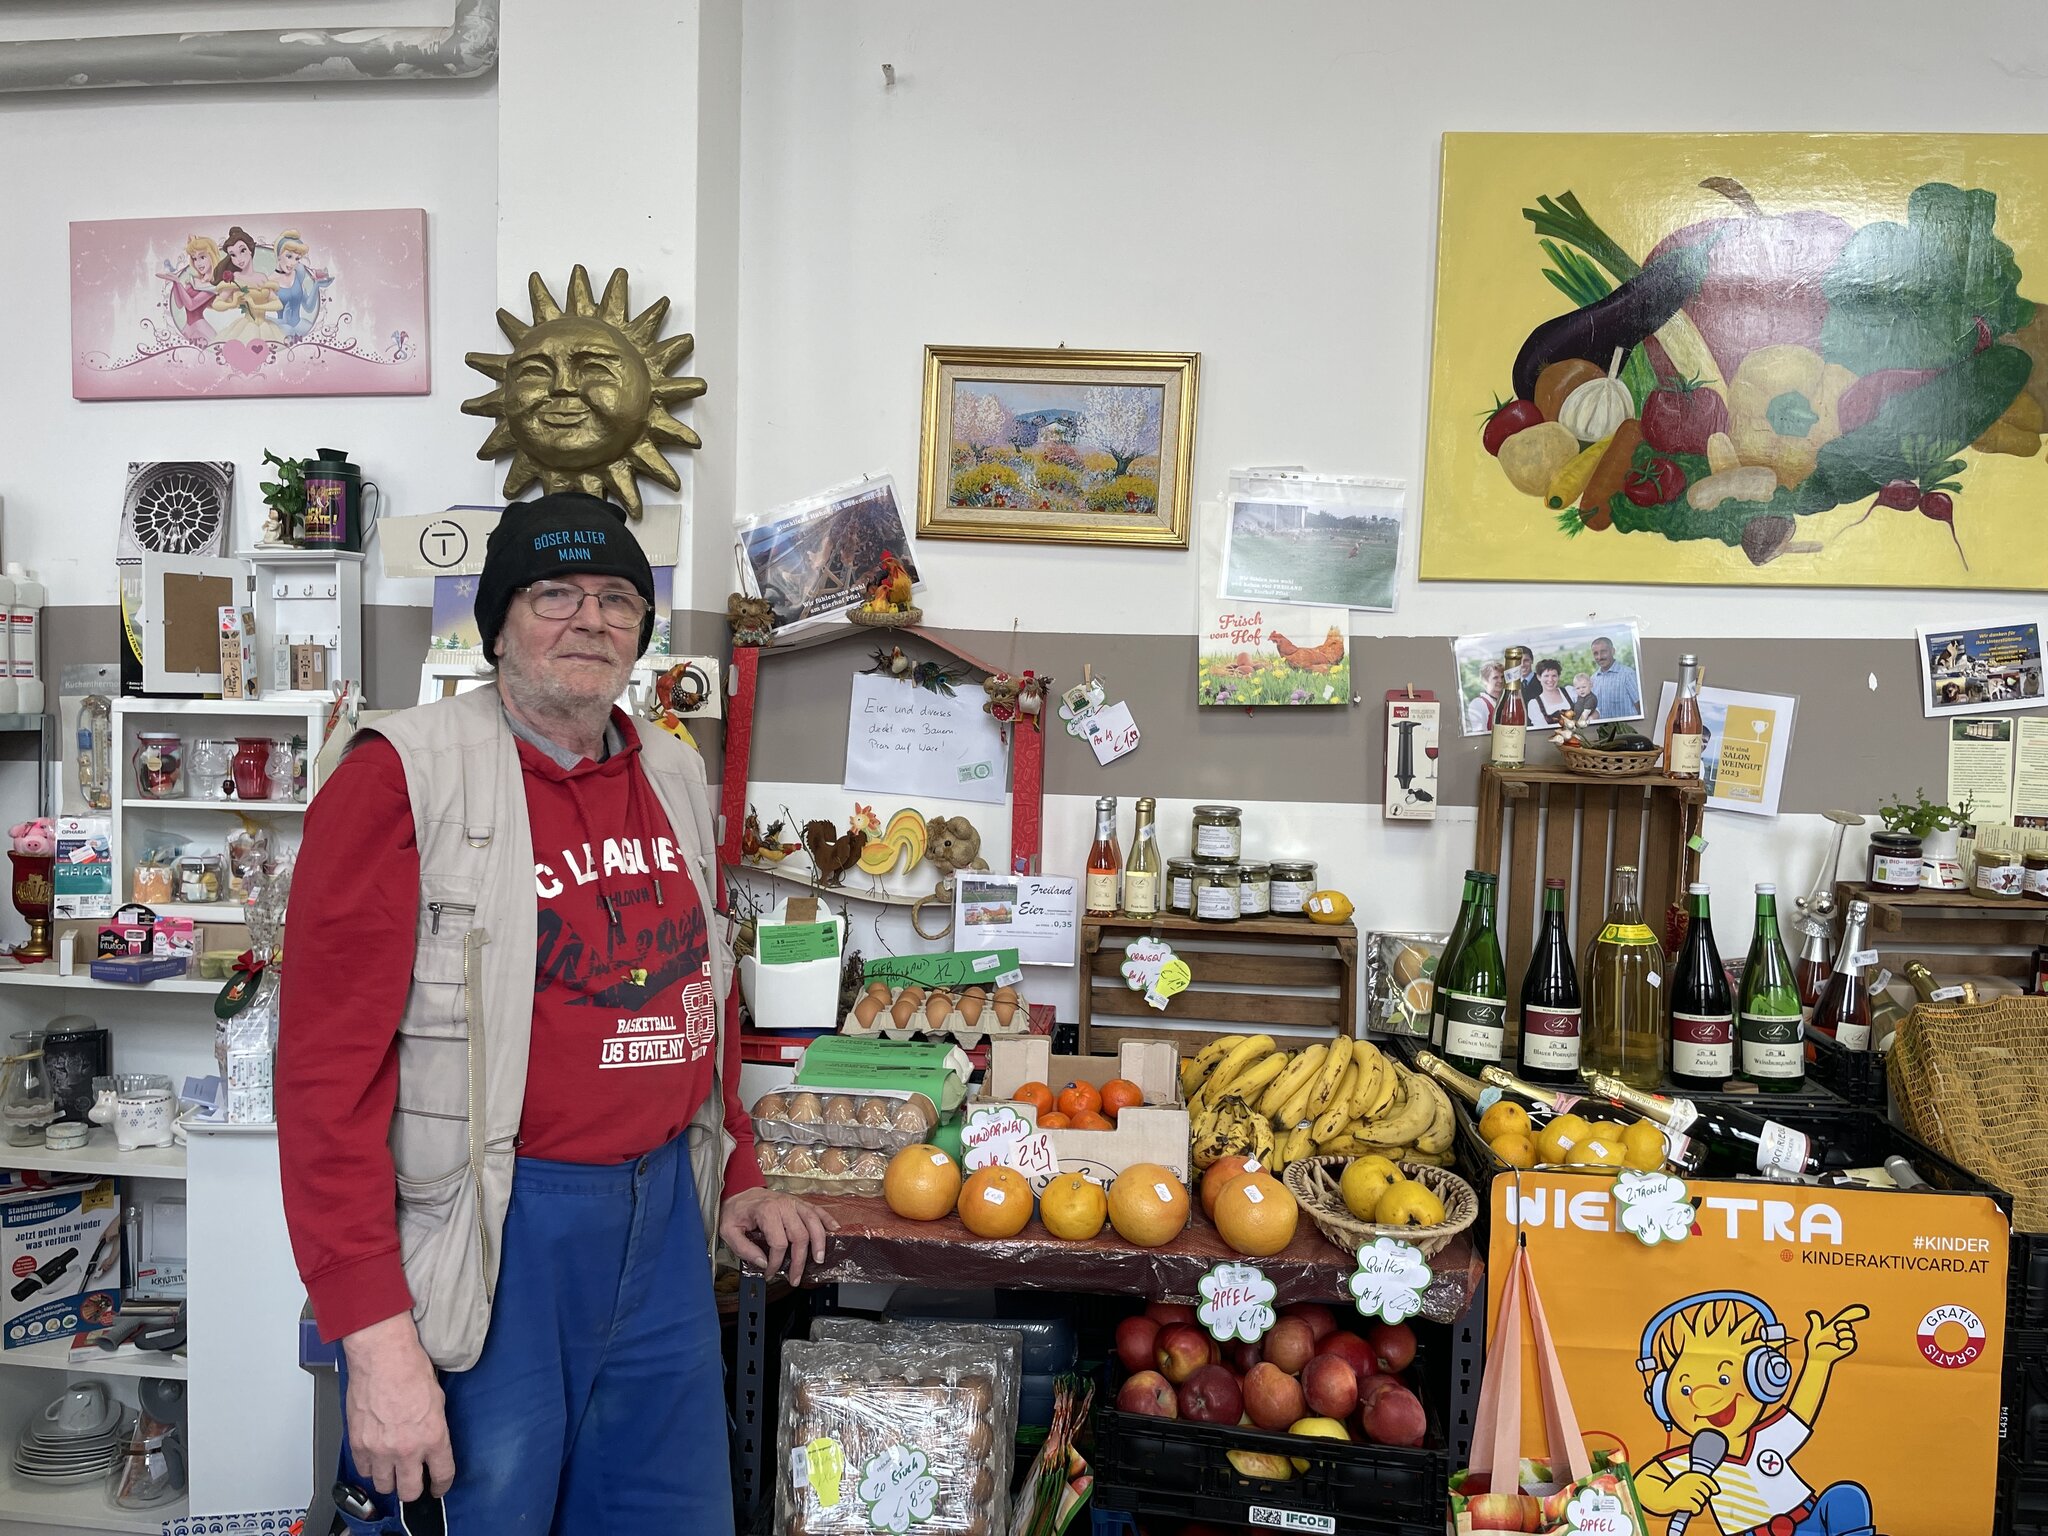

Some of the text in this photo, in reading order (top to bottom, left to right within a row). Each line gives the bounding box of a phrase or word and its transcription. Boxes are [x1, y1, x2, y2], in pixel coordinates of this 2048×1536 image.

[533, 530, 606, 551] BÖSER ALTER
[558, 547, 592, 562] MANN
[850, 583, 866, 592] wohl
[1218, 610, 1263, 630] Frisch
[1209, 628, 1262, 646] vom Hof
[895, 704, 914, 715] und
[894, 742, 912, 754] auf
[1722, 751, 1751, 761] SALON
[1720, 768, 1740, 778] 2023
[1721, 759, 1763, 771] WEINGUT
[1030, 883, 1073, 897] Freiland
[1018, 901, 1045, 917] Eier
[1053, 920, 1072, 929] 0,35
[100, 941, 127, 950] Intuition
[616, 1016, 677, 1034] BASKETBALL
[601, 1045, 625, 1063] US
[1626, 1181, 1669, 1203] ZITRONEN
[7, 1201, 57, 1216] Staubsauger-
[7, 1206, 68, 1224] Kleinteilefilter
[15, 1219, 102, 1243] Jetzt geht nie wieder
[25, 1232, 82, 1251] was verloren!
[1912, 1235, 1990, 1253] #KINDER
[1801, 1250, 1990, 1274] KINDERAKTIVCARD.AT
[1925, 1306, 1979, 1330] GRATIS
[1923, 1343, 1978, 1367] GRATIS
[1998, 1406, 2009, 1439] LL4314
[874, 1482, 886, 1499] 20
[1284, 1511, 1318, 1527] IFCO
